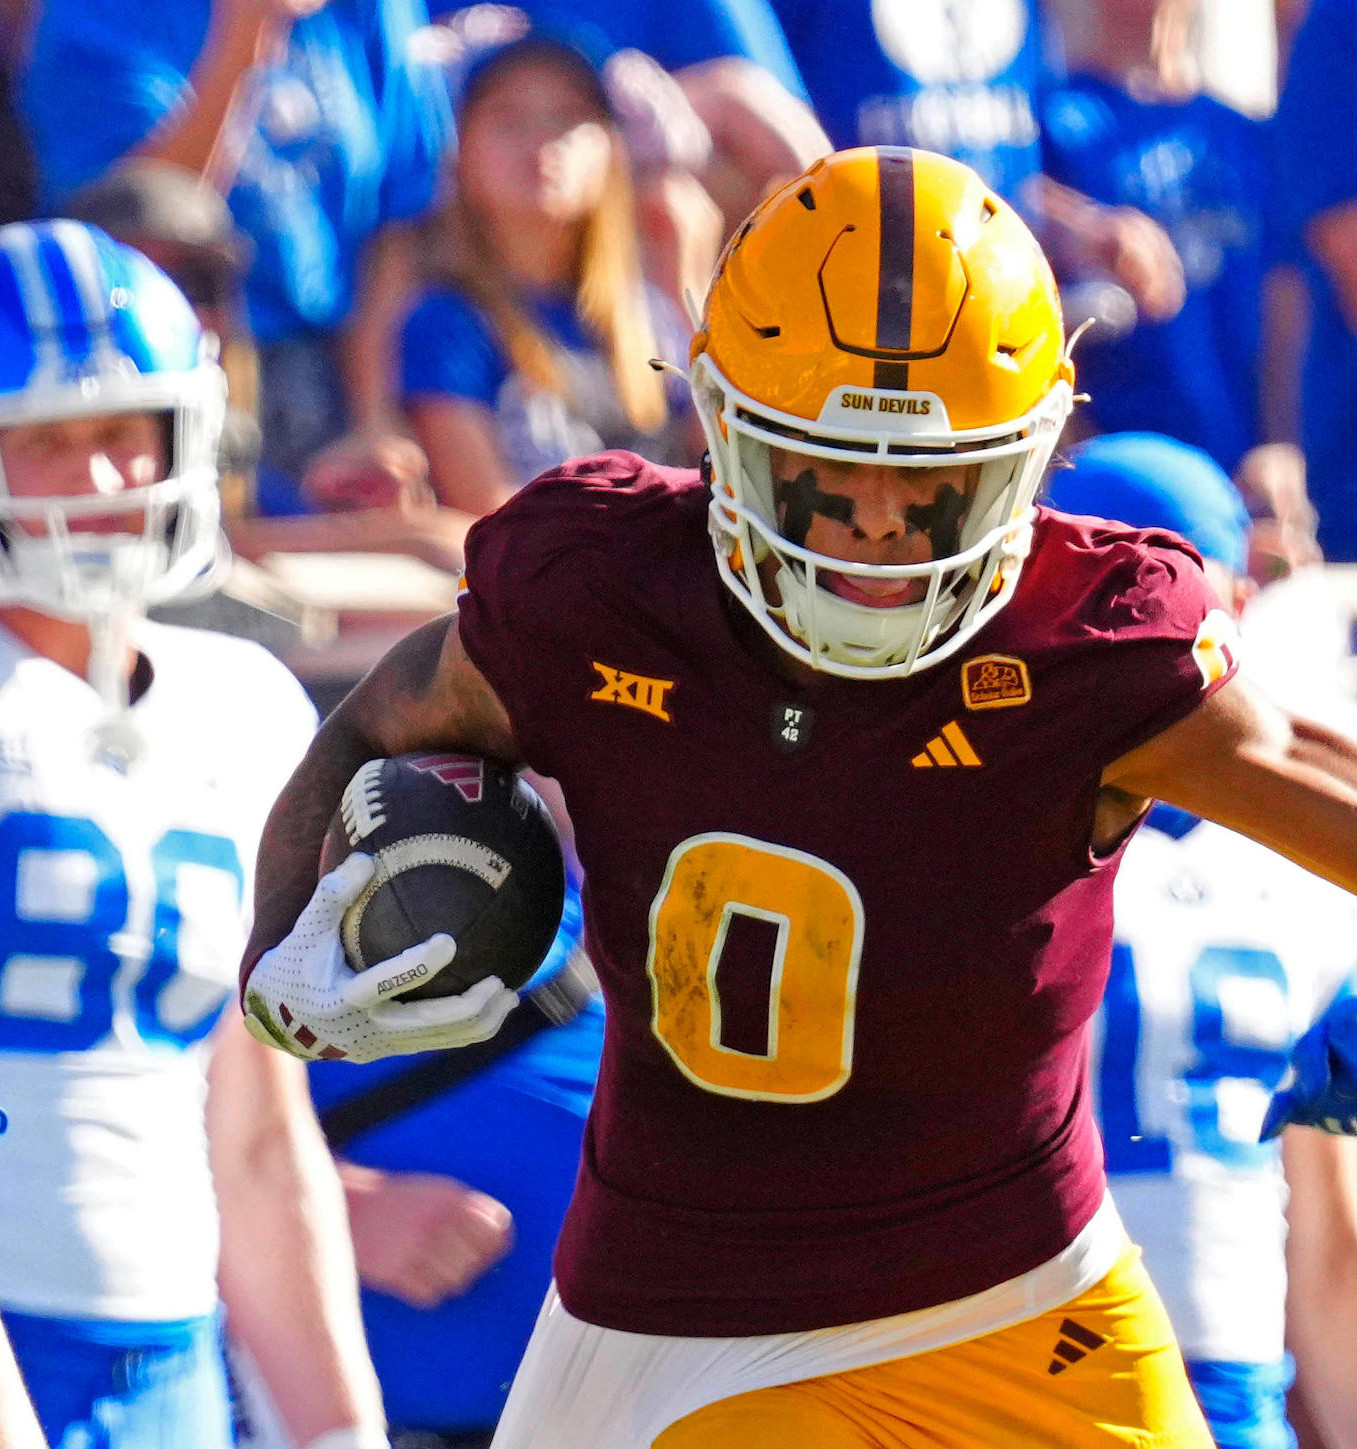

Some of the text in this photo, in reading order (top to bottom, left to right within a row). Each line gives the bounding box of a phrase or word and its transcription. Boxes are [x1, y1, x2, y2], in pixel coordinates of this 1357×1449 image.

[841, 393, 931, 415] SUN DEVILS
[591, 661, 675, 723] XII
[784, 708, 803, 723] PT
[781, 727, 799, 742] 42
[377, 963, 428, 995] ADIZERO
[646, 831, 866, 1104] 0
